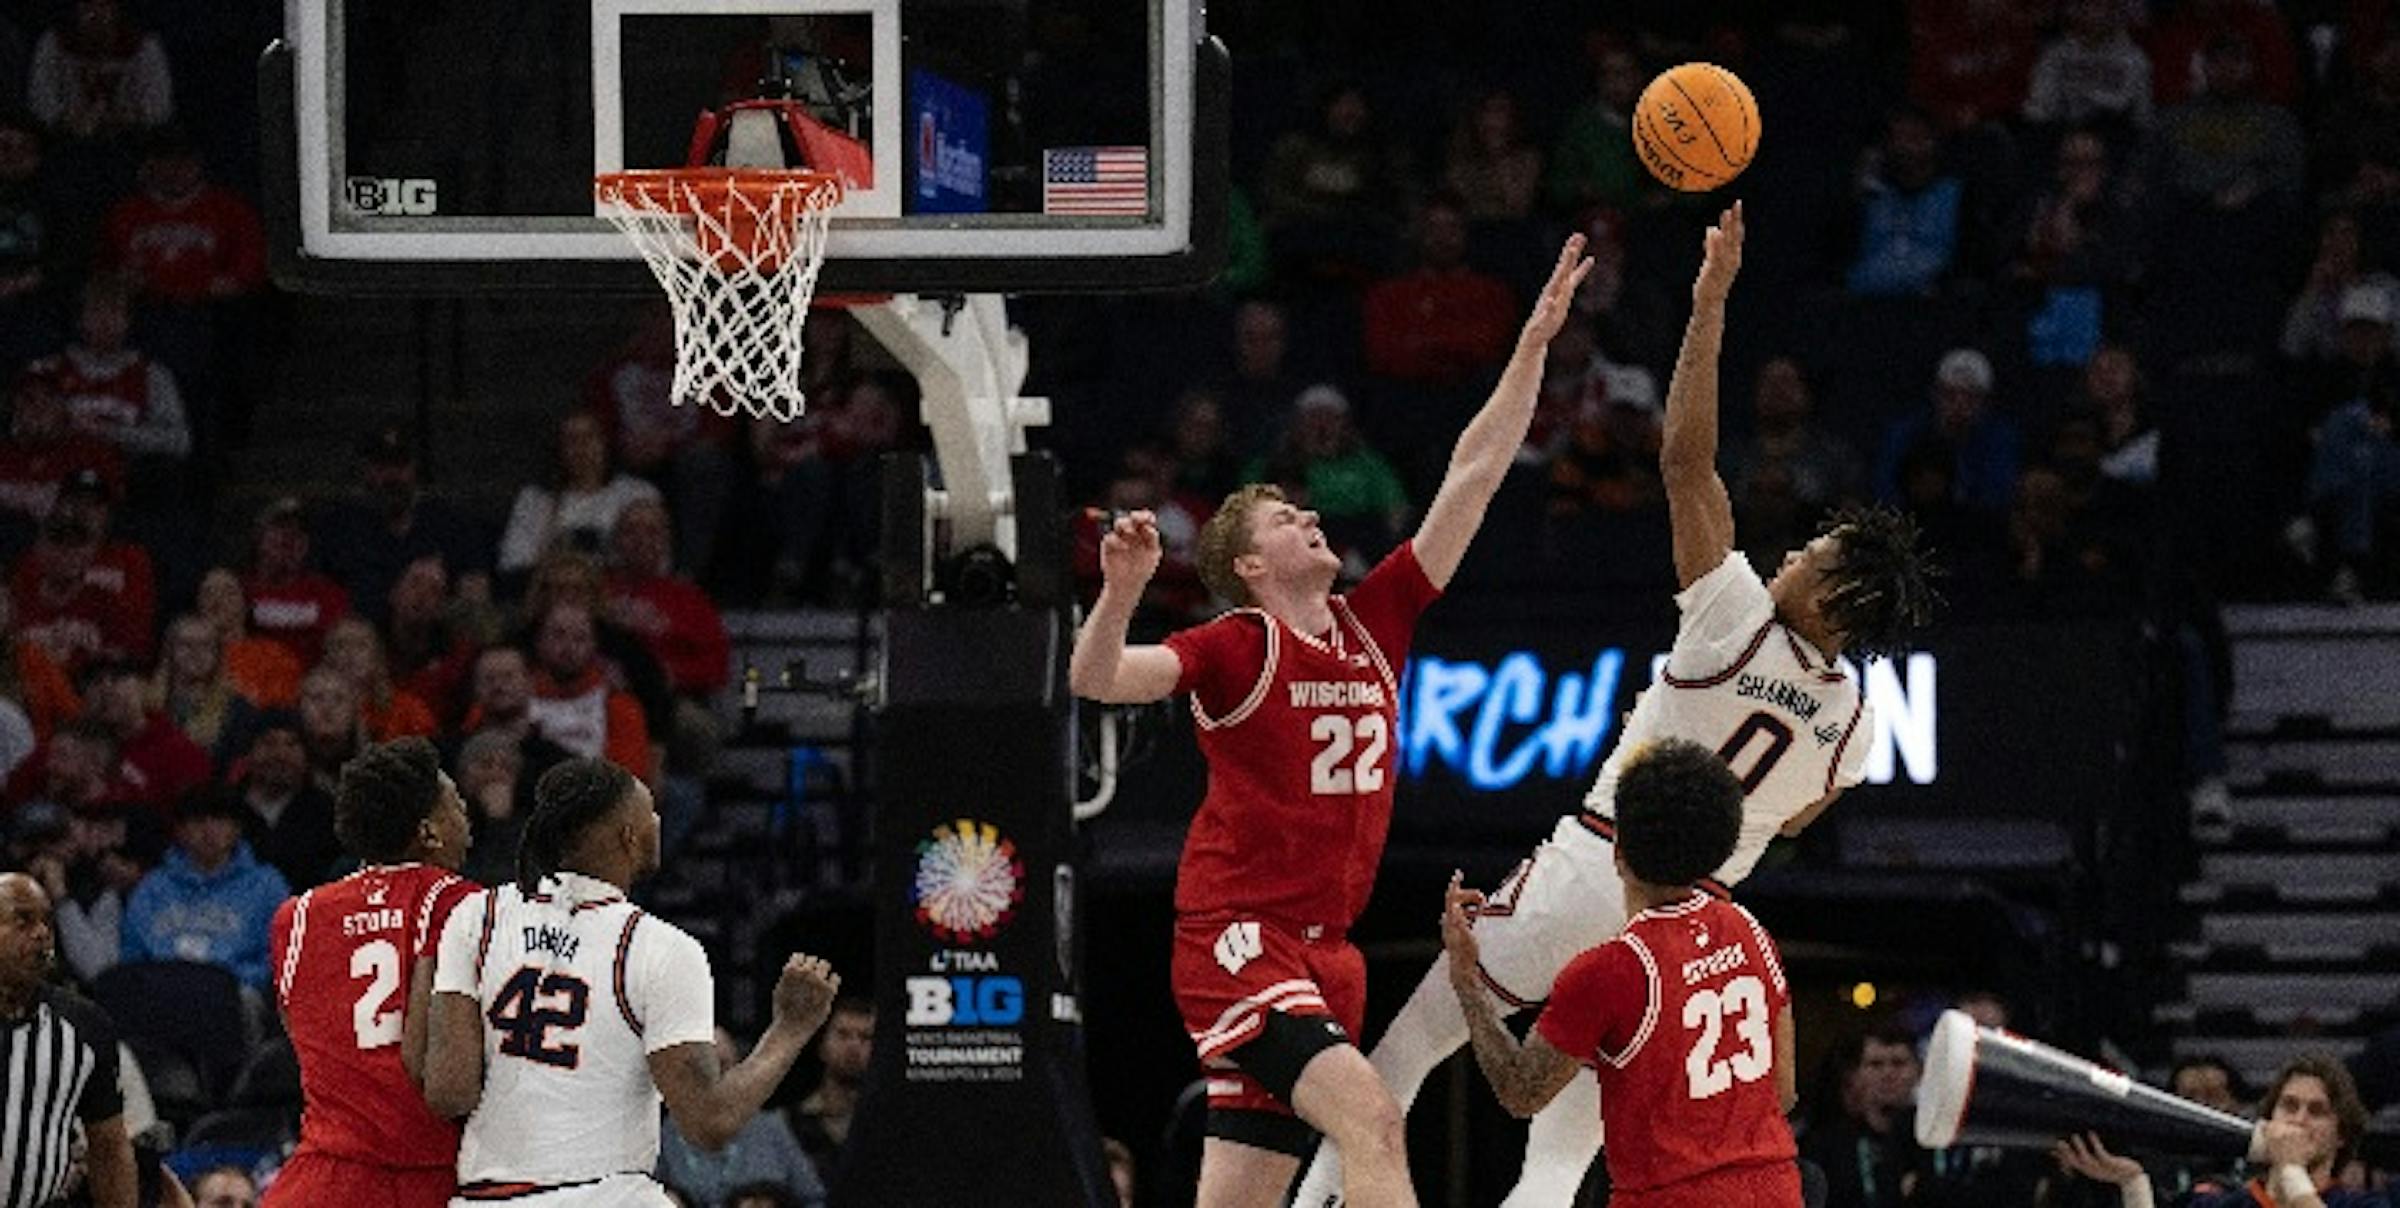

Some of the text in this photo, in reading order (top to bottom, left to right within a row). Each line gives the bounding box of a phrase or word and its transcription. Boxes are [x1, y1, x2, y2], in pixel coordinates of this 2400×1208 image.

[1310, 712, 1388, 796] 22
[1398, 648, 1625, 788] RCH
[1716, 710, 1795, 797] 0
[350, 938, 404, 1050] 2
[954, 951, 999, 972] TIAA
[485, 963, 592, 1071] 42
[906, 1046, 1024, 1066] TOURNAMENT
[1682, 974, 1774, 1099] 23
